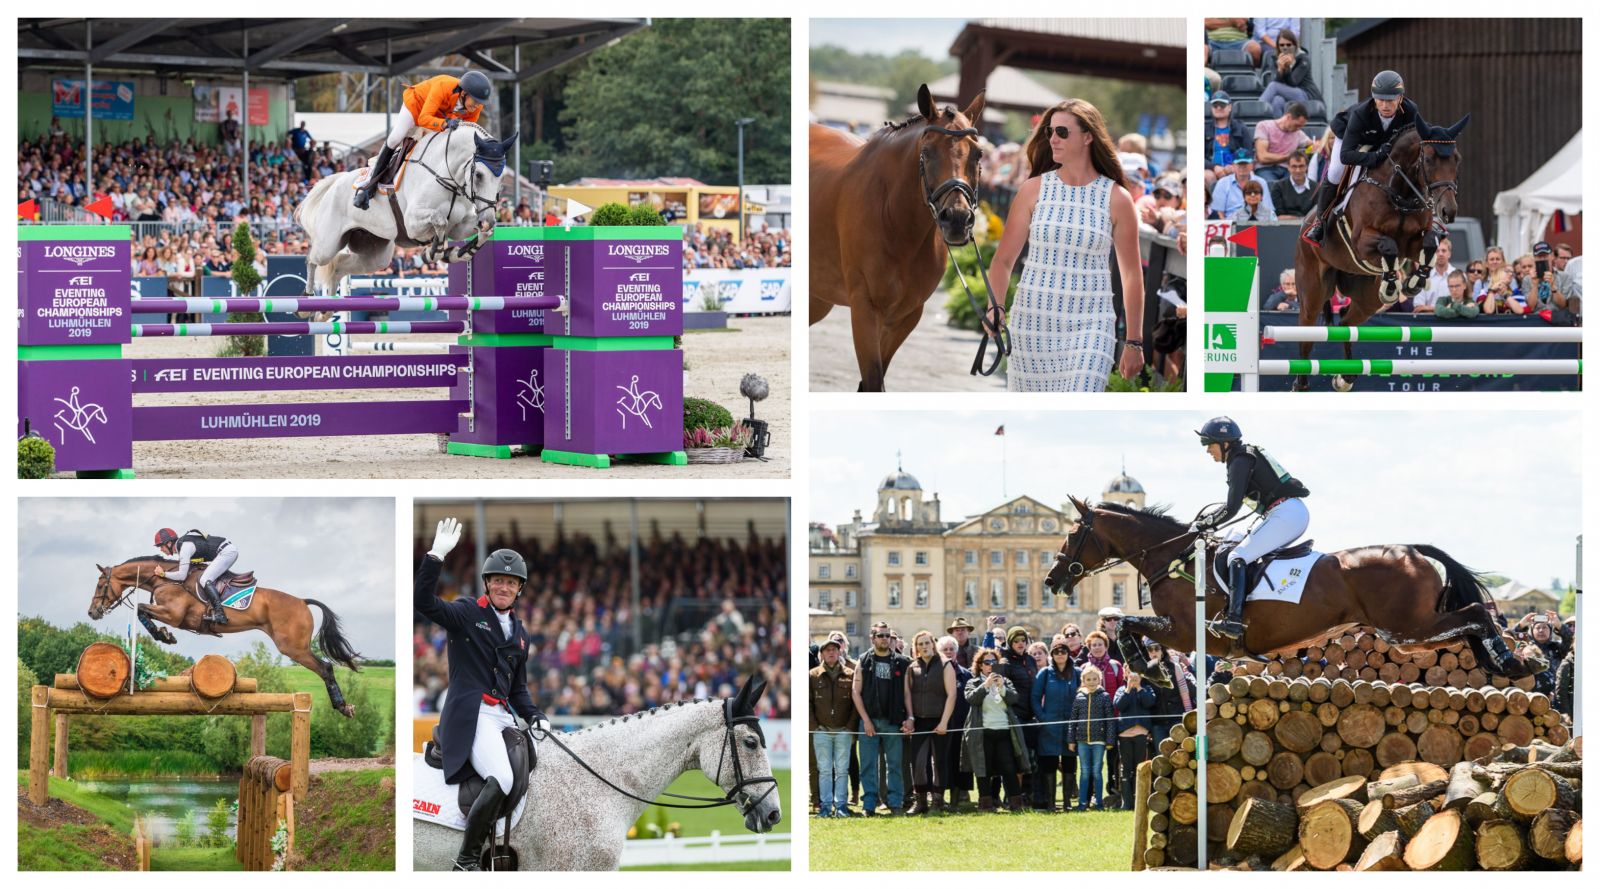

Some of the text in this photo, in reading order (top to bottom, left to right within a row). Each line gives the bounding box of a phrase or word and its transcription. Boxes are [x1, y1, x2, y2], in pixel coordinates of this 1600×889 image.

[44, 246, 116, 258] LONGINES
[608, 245, 670, 256] LONGINES
[55, 288, 105, 298] EVENTING
[617, 284, 661, 293] EVENTING
[761, 281, 782, 298] SAP
[52, 298, 107, 307] EUROPEAN
[615, 293, 662, 302] EUROPEAN
[602, 302, 676, 311] CHAMPIONSHIPS
[37, 307, 123, 317] CHAMPIONSHIPS
[612, 310, 666, 321] LUHMÜHLEN
[49, 316, 111, 328] LUHMÜHLEN
[629, 321, 649, 330] 2019
[68, 328, 92, 337] 2019
[1396, 346, 1433, 356] THE
[1204, 353, 1237, 362] RUNG
[193, 366, 263, 381] EVENTING
[266, 365, 340, 380] EUROPEAN
[343, 364, 457, 379] CHAMPIONSHIPS
[1388, 382, 1441, 391] TOUR
[201, 412, 322, 429] LUHMÜHLEN 2019
[413, 799, 441, 814] GAIN
